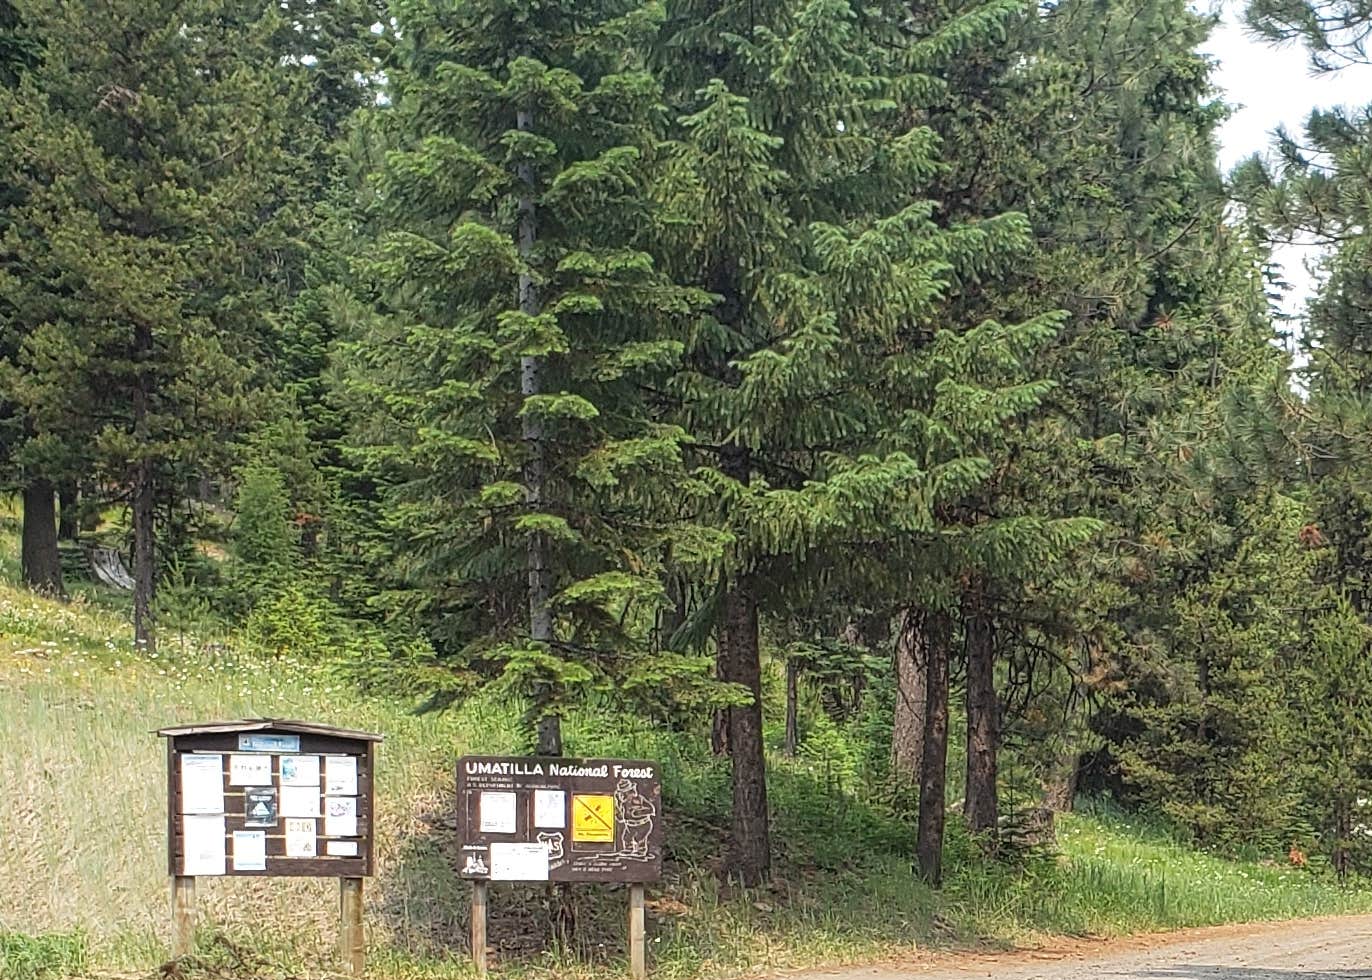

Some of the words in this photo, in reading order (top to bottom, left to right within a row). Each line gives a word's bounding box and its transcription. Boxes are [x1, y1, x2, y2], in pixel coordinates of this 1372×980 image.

[465, 762, 544, 776] UMATILLA
[549, 764, 609, 778] National
[613, 765, 654, 779] Forest
